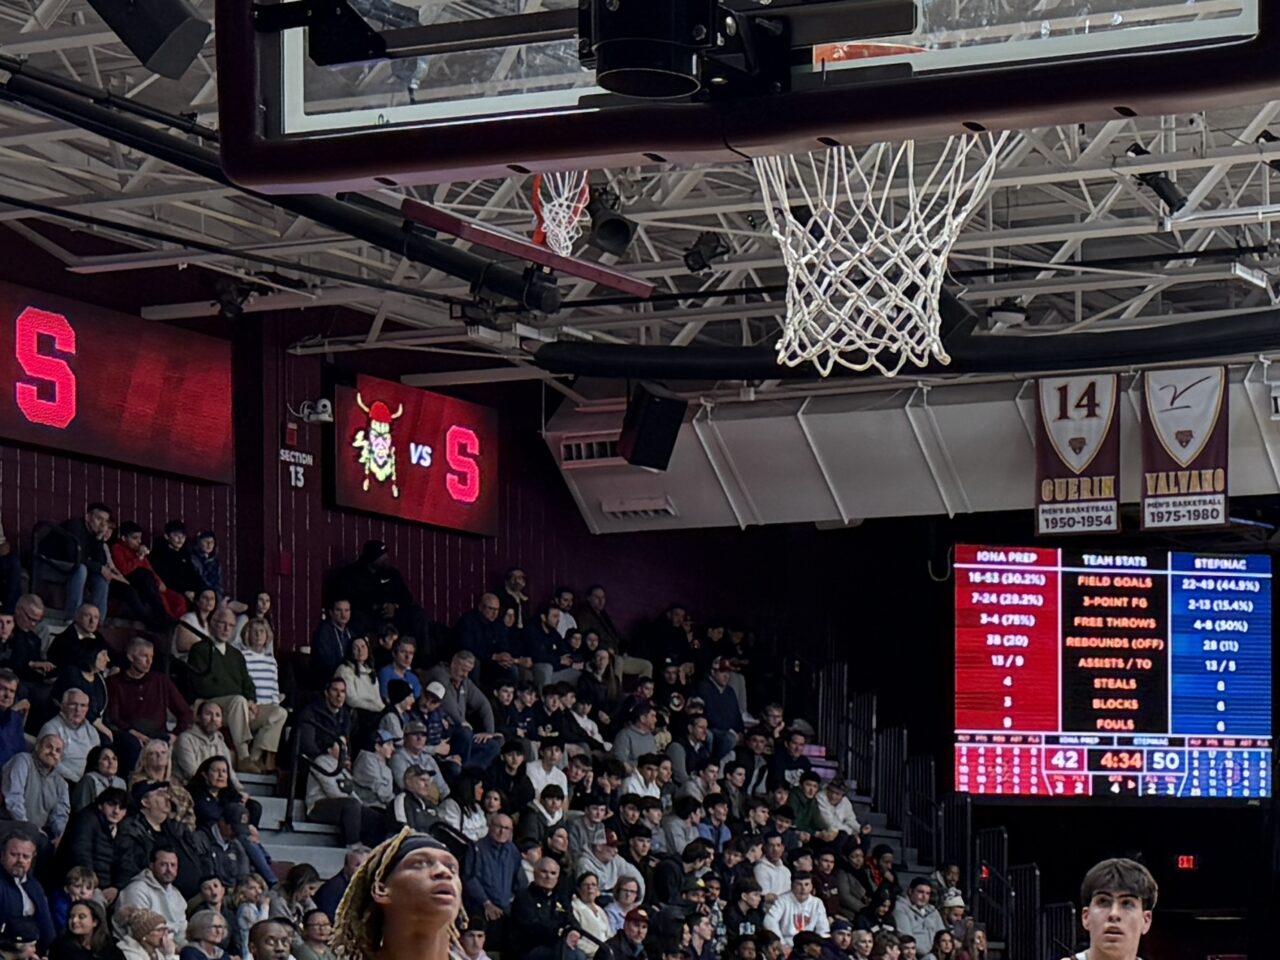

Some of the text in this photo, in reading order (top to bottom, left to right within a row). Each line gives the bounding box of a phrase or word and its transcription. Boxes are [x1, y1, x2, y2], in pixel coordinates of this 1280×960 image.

[16, 306, 76, 429] S
[1053, 381, 1101, 422] 14
[280, 448, 313, 466] SECTION
[409, 425, 480, 503] VS S
[289, 465, 305, 488] 13
[1145, 468, 1225, 495] VALVANO
[1041, 475, 1116, 502] GUERIN
[1066, 504, 1114, 514] BASKETBALL
[1172, 498, 1222, 508] BASKETBALL
[1044, 515, 1113, 529] 1950-1954
[1149, 508, 1220, 523] 1975-1980
[977, 551, 1038, 563] IONA PREP
[1082, 554, 1148, 567] TEAM STATS
[1194, 558, 1247, 570] STEPINAC
[1077, 575, 1153, 588] FIELD GOALS
[1083, 596, 1148, 608] 3-POINT FG
[1074, 616, 1157, 629] FREE THROWS
[1066, 637, 1164, 650] REBOUNDS (OFF)
[1078, 657, 1125, 669] ASSISTS
[1135, 658, 1153, 670] TO
[1002, 675, 1013, 687] 4
[1093, 678, 1137, 690] STEALS
[1092, 698, 1139, 710] BLOCKS
[1096, 718, 1135, 730] FOULS
[1051, 750, 1079, 769] 42
[1100, 752, 1142, 769] 4:34
[1152, 752, 1180, 769] 50
